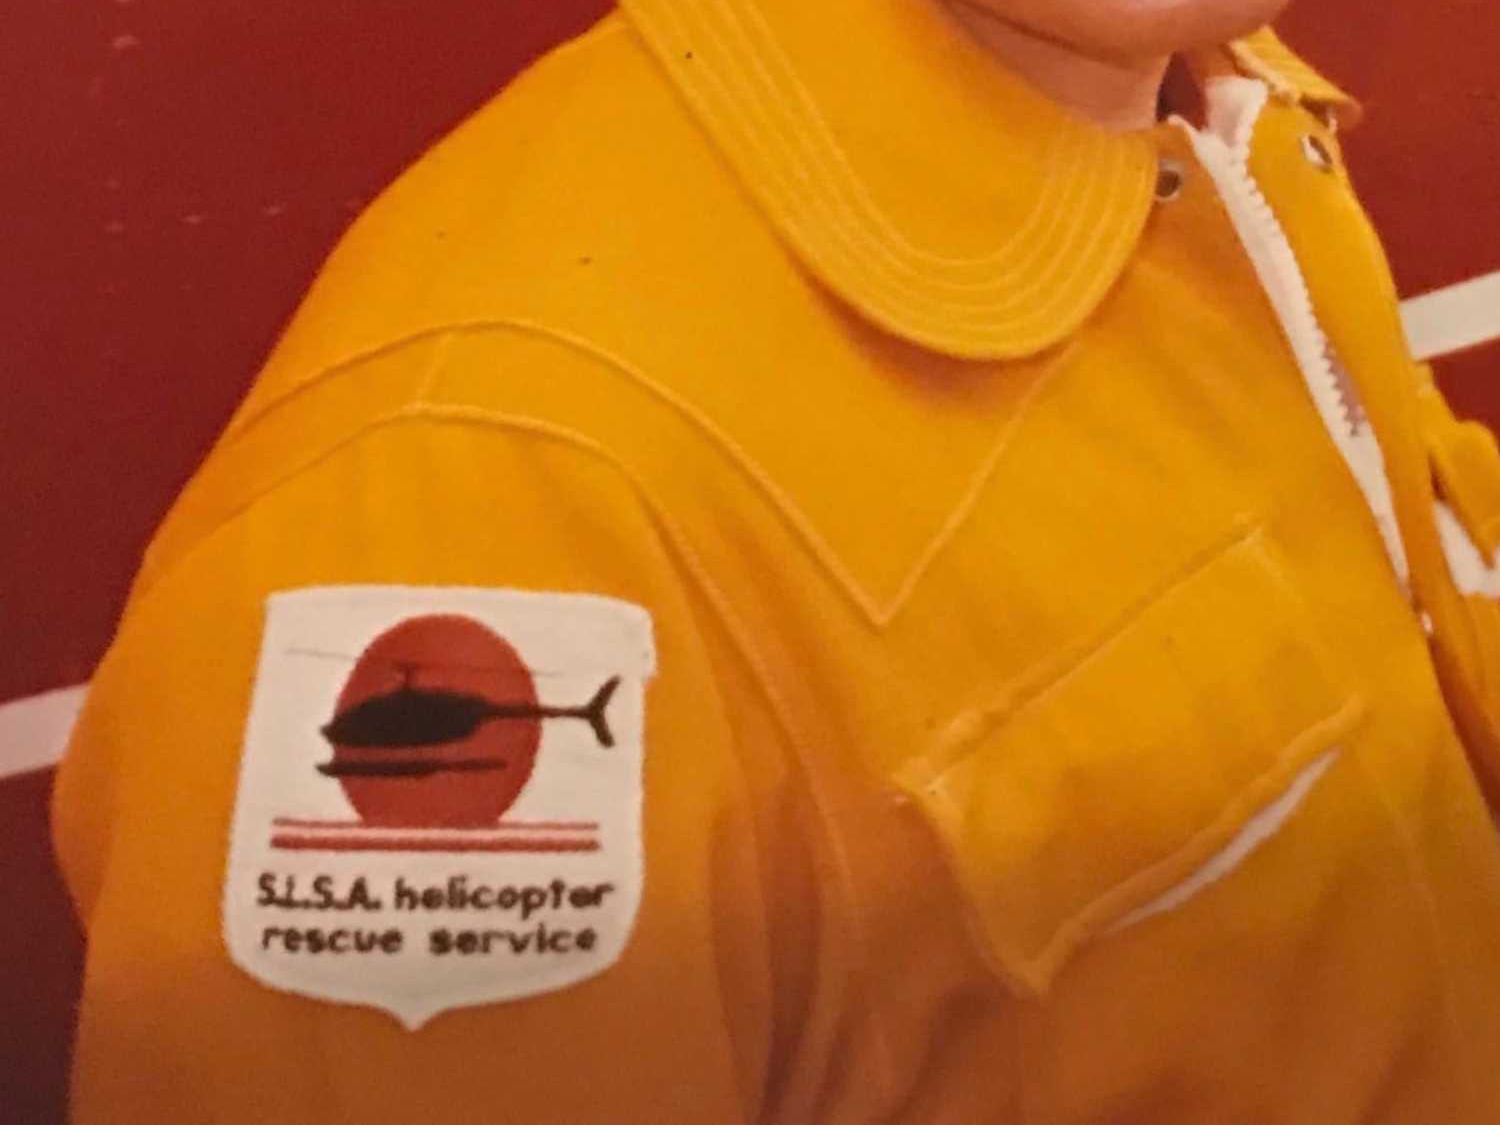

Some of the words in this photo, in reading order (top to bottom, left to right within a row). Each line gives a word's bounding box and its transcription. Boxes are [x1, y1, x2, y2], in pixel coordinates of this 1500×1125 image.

[394, 875, 615, 920] helicopter
[261, 924, 404, 953] rescue
[427, 922, 599, 955] service
